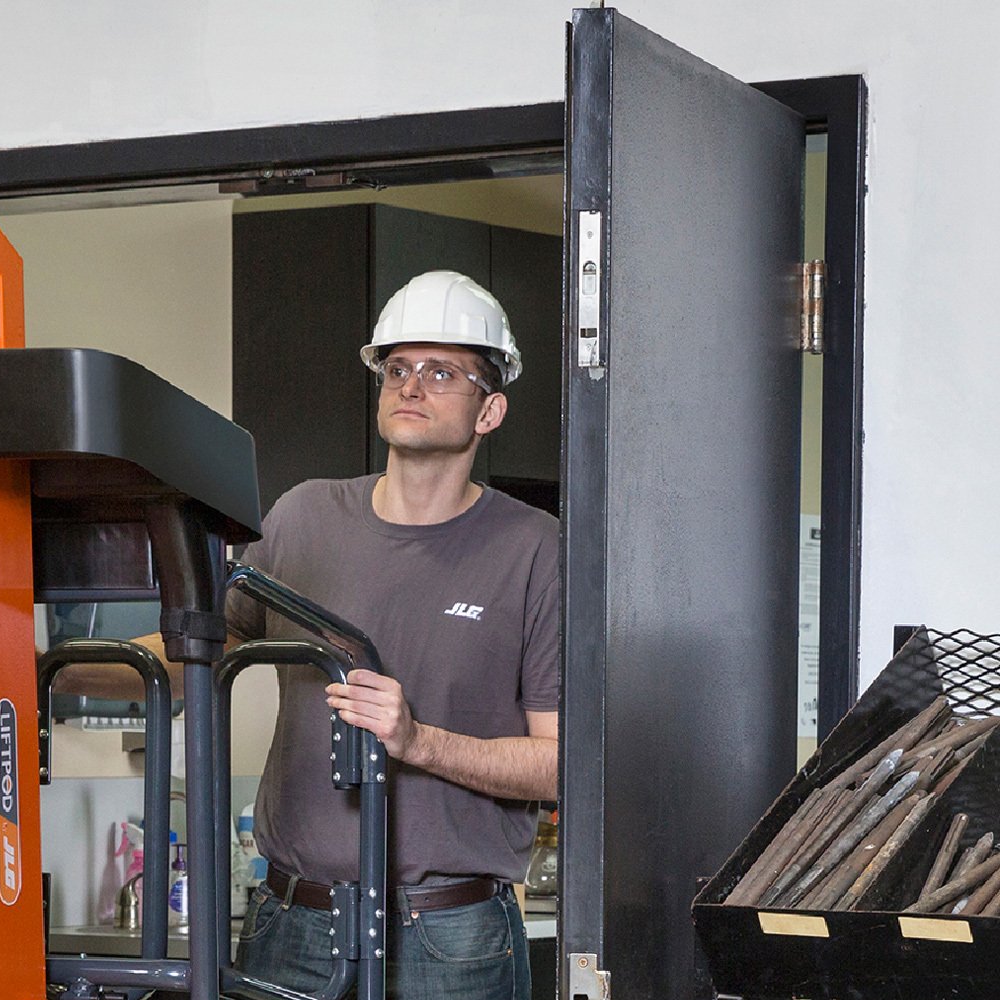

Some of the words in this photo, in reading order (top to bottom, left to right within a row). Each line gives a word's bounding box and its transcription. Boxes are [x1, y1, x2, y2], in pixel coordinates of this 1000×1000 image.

[444, 602, 484, 620] JLG
[0, 712, 14, 812] LIFTPOD
[3, 835, 16, 890] JLG
